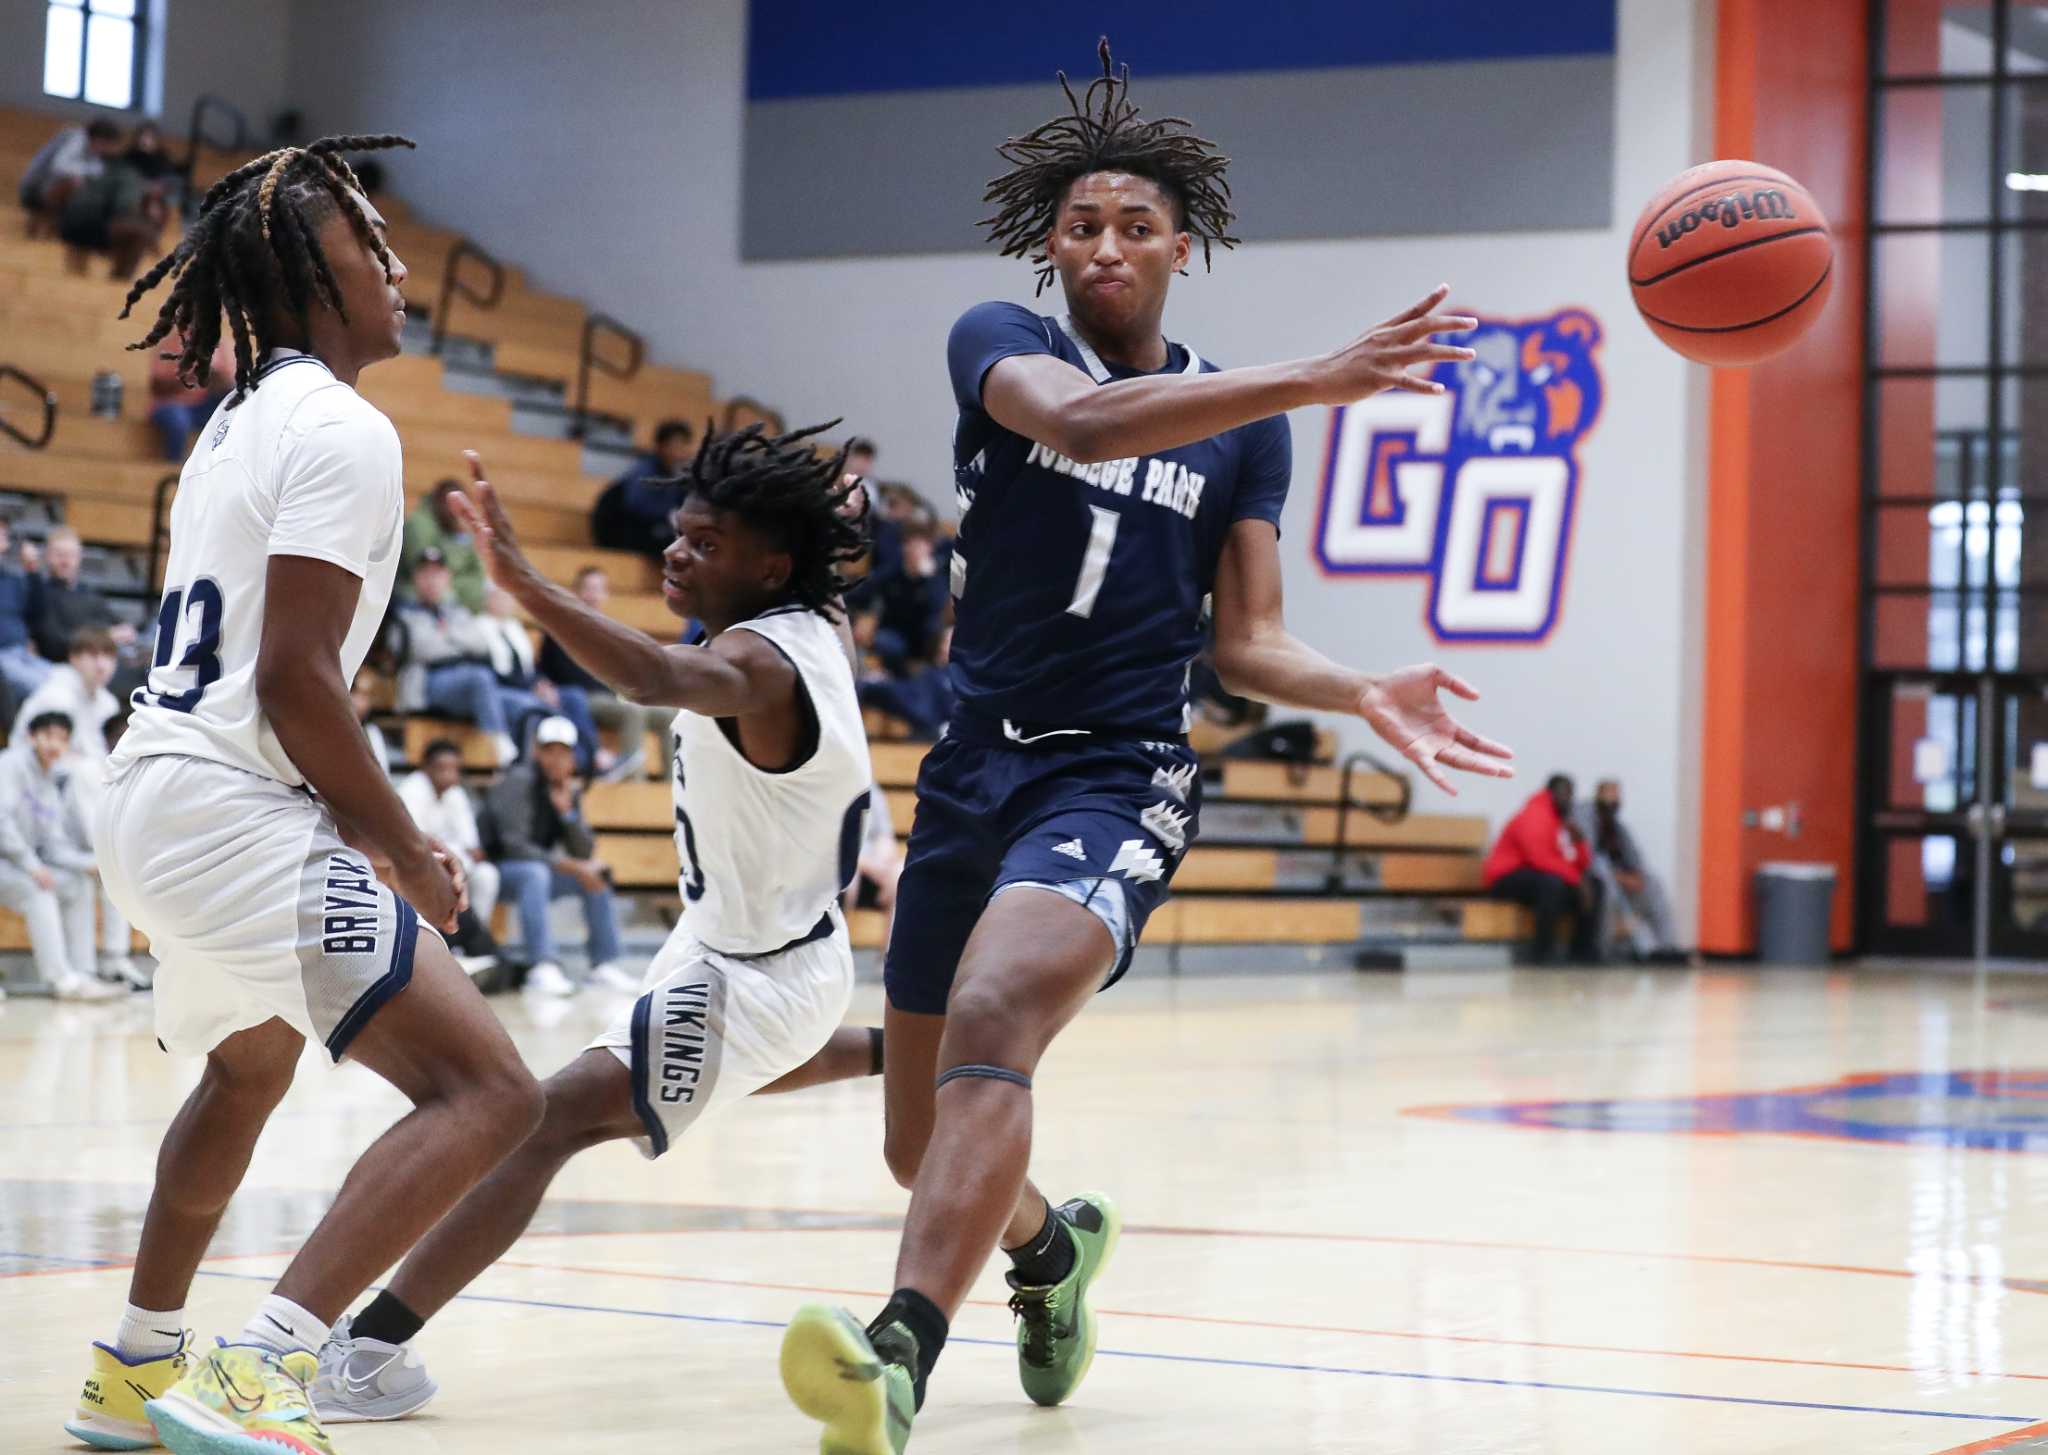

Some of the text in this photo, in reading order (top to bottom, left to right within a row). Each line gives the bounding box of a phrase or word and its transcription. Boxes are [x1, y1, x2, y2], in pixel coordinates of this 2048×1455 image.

[1656, 189, 1796, 249] Wilson
[1065, 504, 1121, 618] 1
[1318, 390, 1575, 638] GO
[661, 983, 709, 1103] VIKINGS
